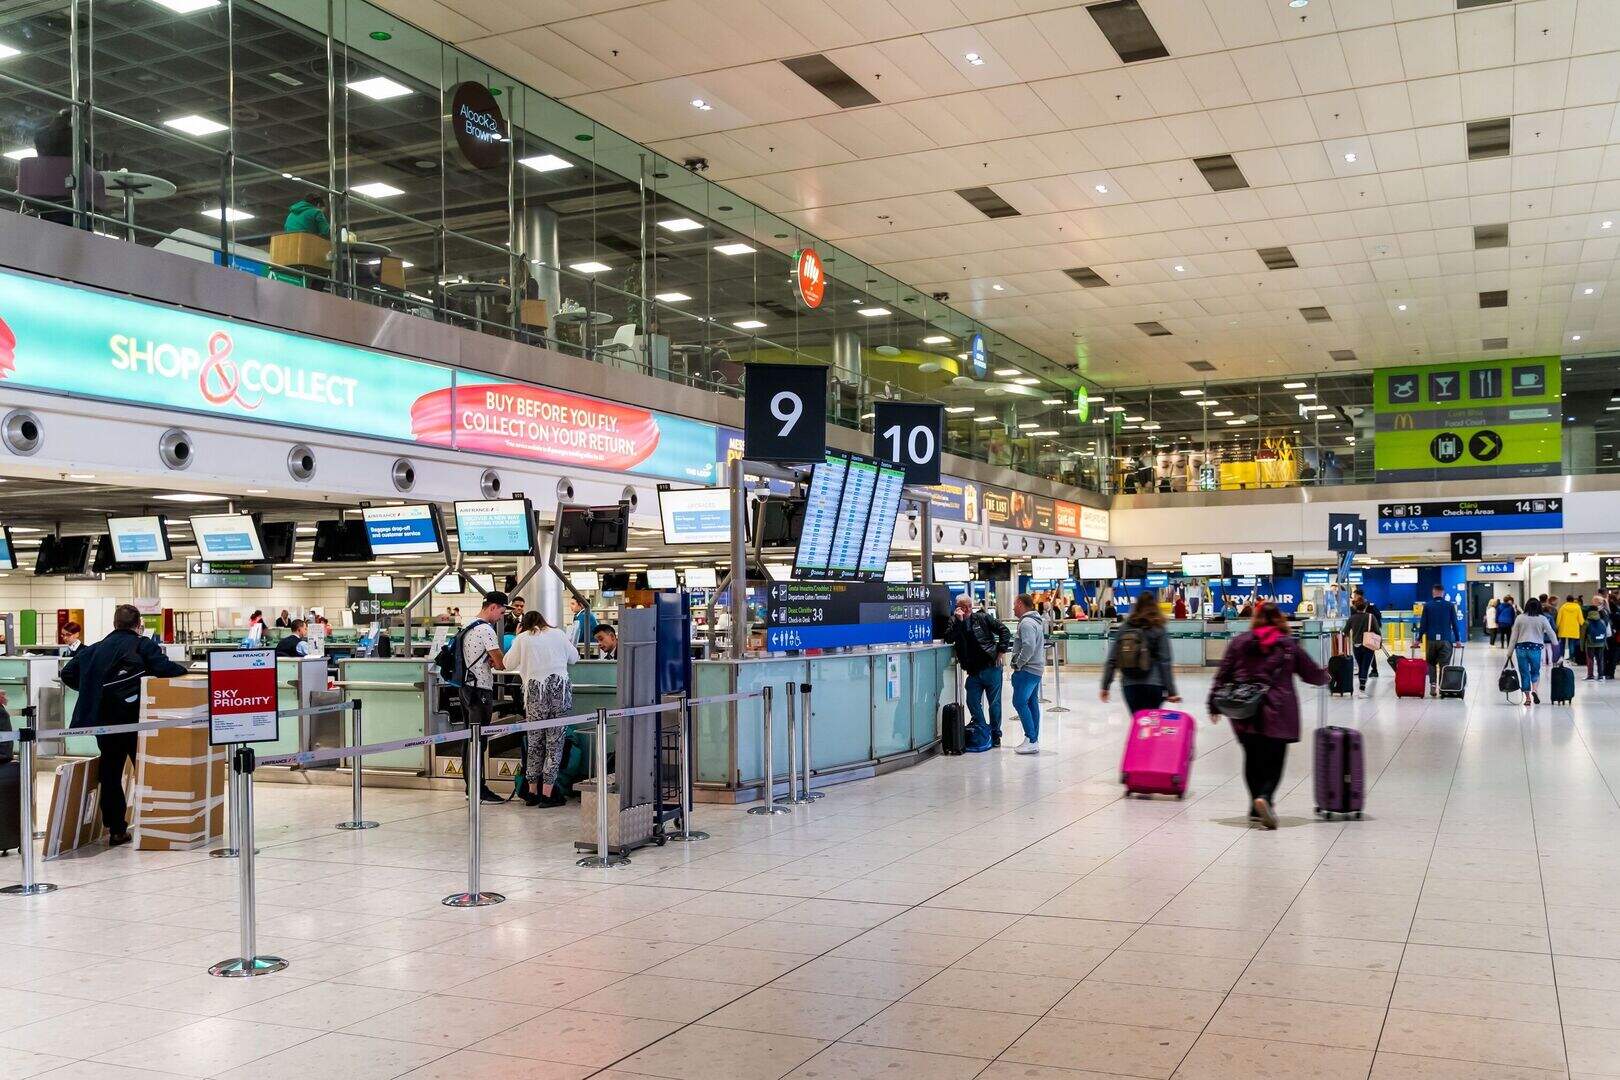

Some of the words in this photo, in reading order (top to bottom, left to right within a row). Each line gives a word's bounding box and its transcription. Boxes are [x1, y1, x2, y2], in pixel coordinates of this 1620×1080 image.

[460, 104, 489, 128] Alcock
[465, 121, 493, 144] Brown
[803, 254, 819, 285] illy
[110, 334, 200, 380] SHOP
[198, 330, 264, 410] &
[240, 359, 358, 408] COLLECT
[486, 391, 513, 413] BUY
[516, 397, 568, 424] BEFORE
[570, 408, 595, 428] YOU
[598, 415, 619, 433] FLY.
[770, 391, 803, 437] 9
[462, 411, 525, 438] COLLECT
[528, 423, 549, 442] ON
[551, 428, 587, 449] YOUR
[1465, 418, 1487, 426] Court
[882, 425, 935, 465] 10
[1407, 505, 1422, 516] 13
[1442, 509, 1473, 517] Check-in
[1474, 508, 1495, 516] Areas
[1516, 502, 1531, 512] 14
[392, 525, 411, 533] drop-off
[1333, 523, 1354, 542] 11
[1454, 538, 1478, 555] 13
[788, 593, 804, 602] Departure
[906, 587, 919, 599] 10-14
[812, 607, 823, 622] 3-8
[213, 689, 239, 699] SKY
[213, 696, 270, 708] PRIORITY
